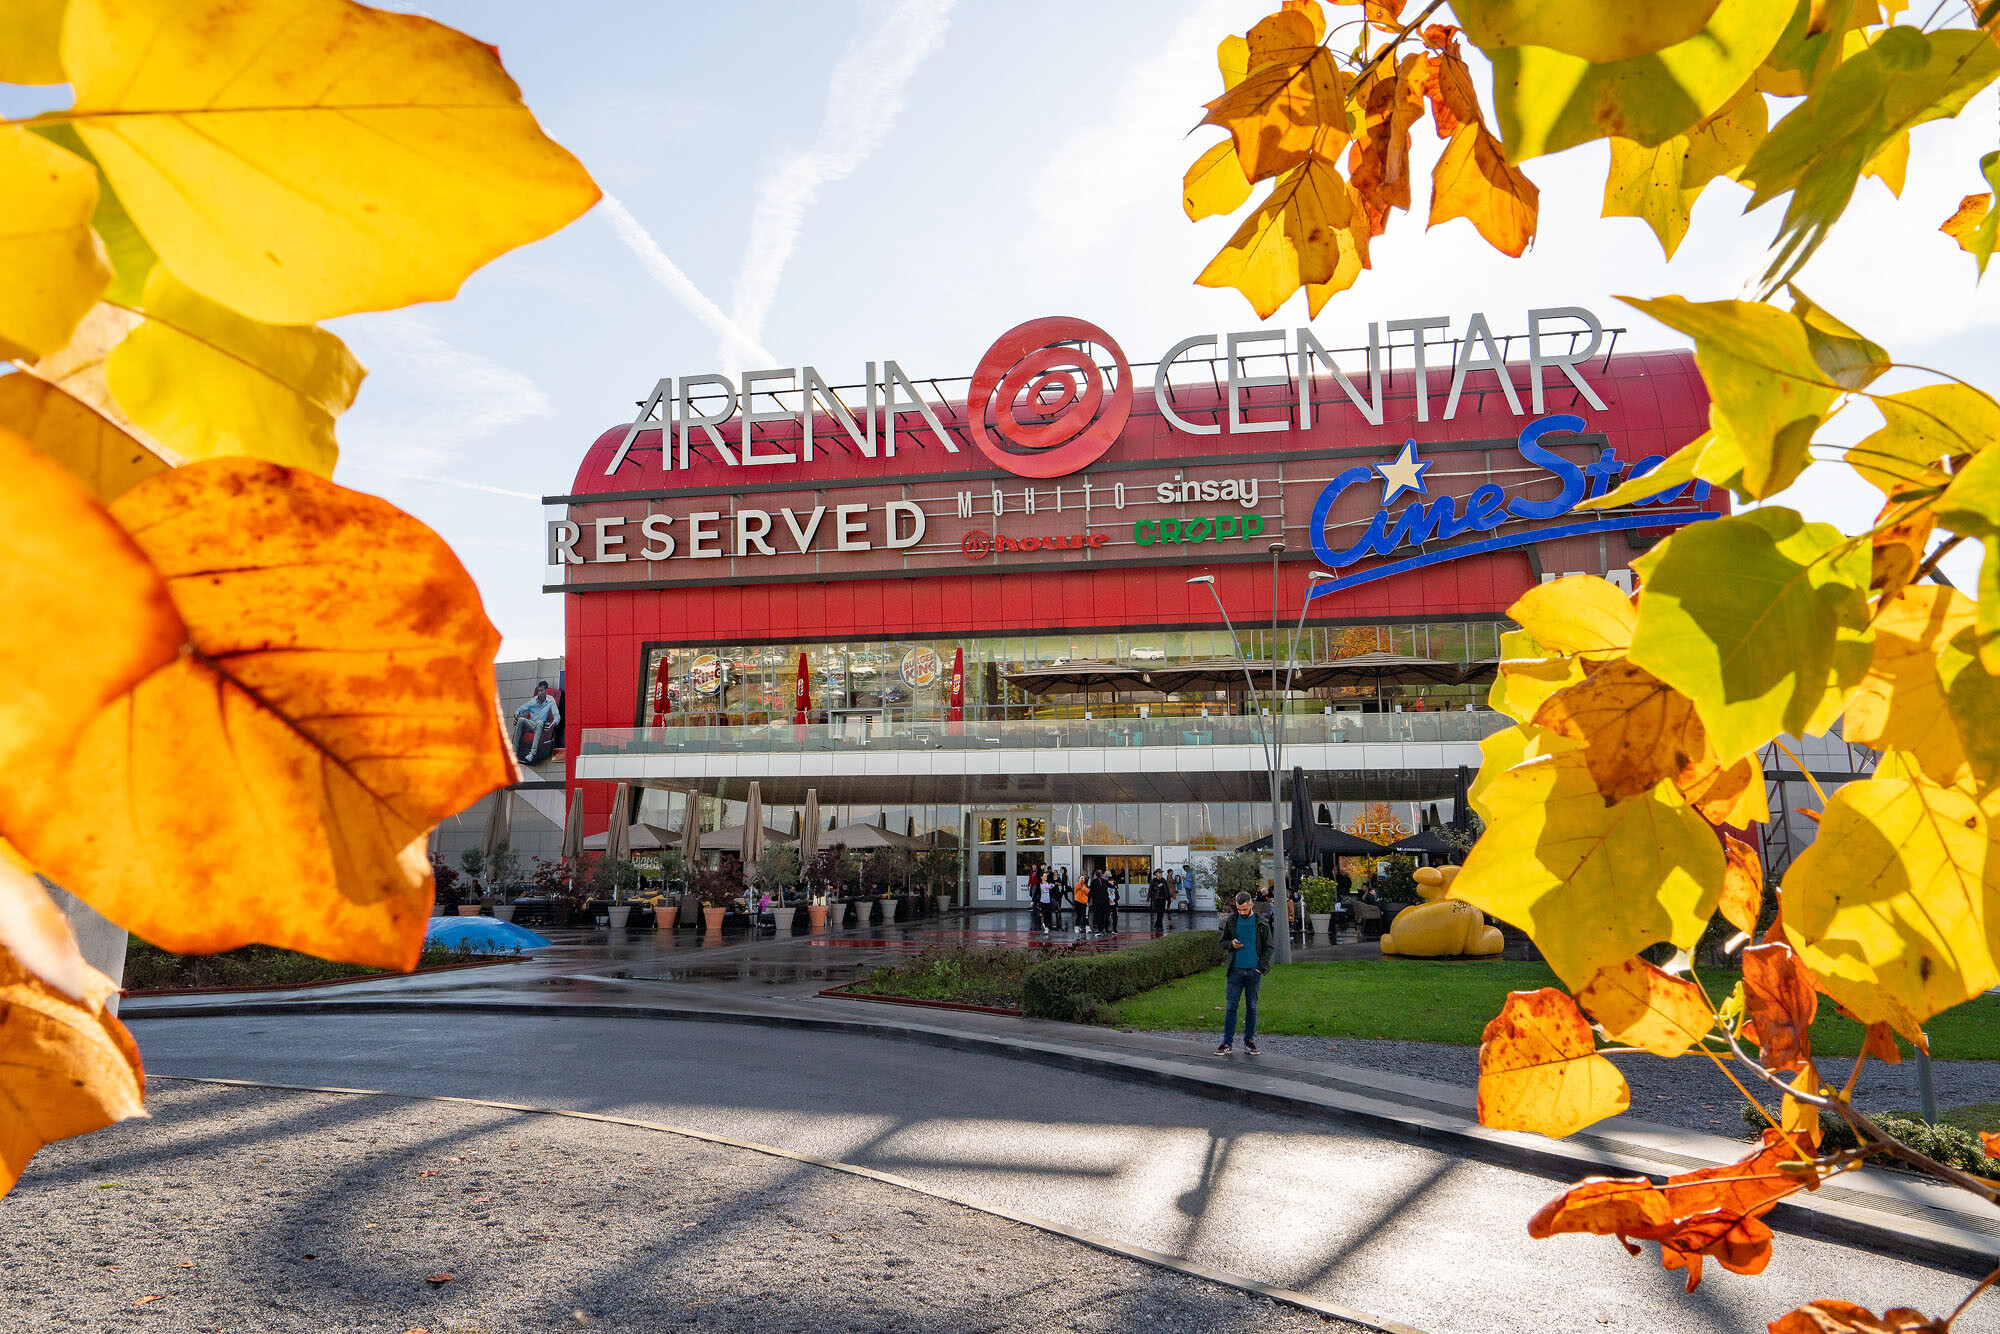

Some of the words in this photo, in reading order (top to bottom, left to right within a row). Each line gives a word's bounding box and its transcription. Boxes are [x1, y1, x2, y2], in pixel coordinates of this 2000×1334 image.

[605, 360, 960, 476] ARENA
[1154, 306, 1609, 436] CENTAR
[957, 481, 1126, 519] MOHITO
[1157, 474, 1259, 508] sinsay
[1309, 414, 1712, 568] CineSta
[547, 500, 926, 566] RESERVED
[1134, 513, 1264, 546] CROPP
